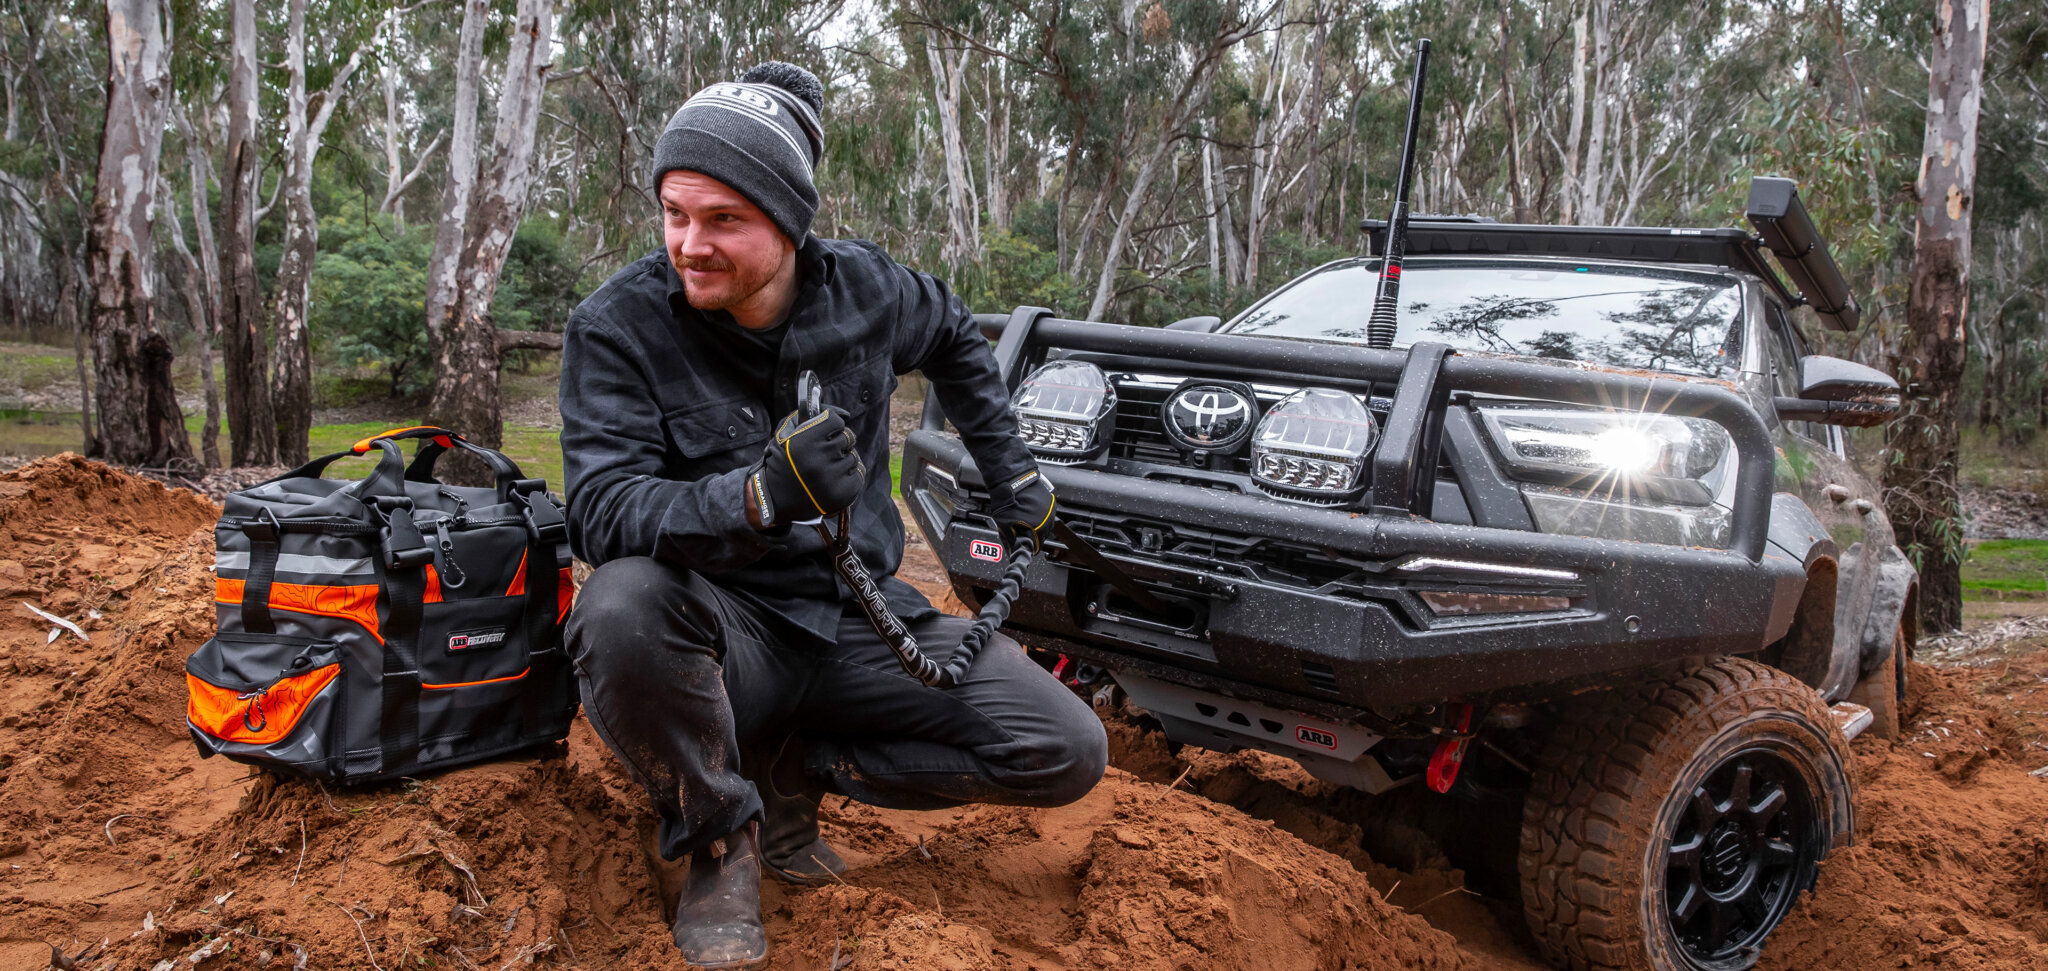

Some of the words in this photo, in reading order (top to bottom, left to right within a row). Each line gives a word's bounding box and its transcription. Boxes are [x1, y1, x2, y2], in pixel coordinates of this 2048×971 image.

[975, 544, 998, 557] ARB
[841, 555, 903, 637] COVERT
[467, 632, 506, 646] RECOVERY
[1301, 730, 1333, 746] ARB
